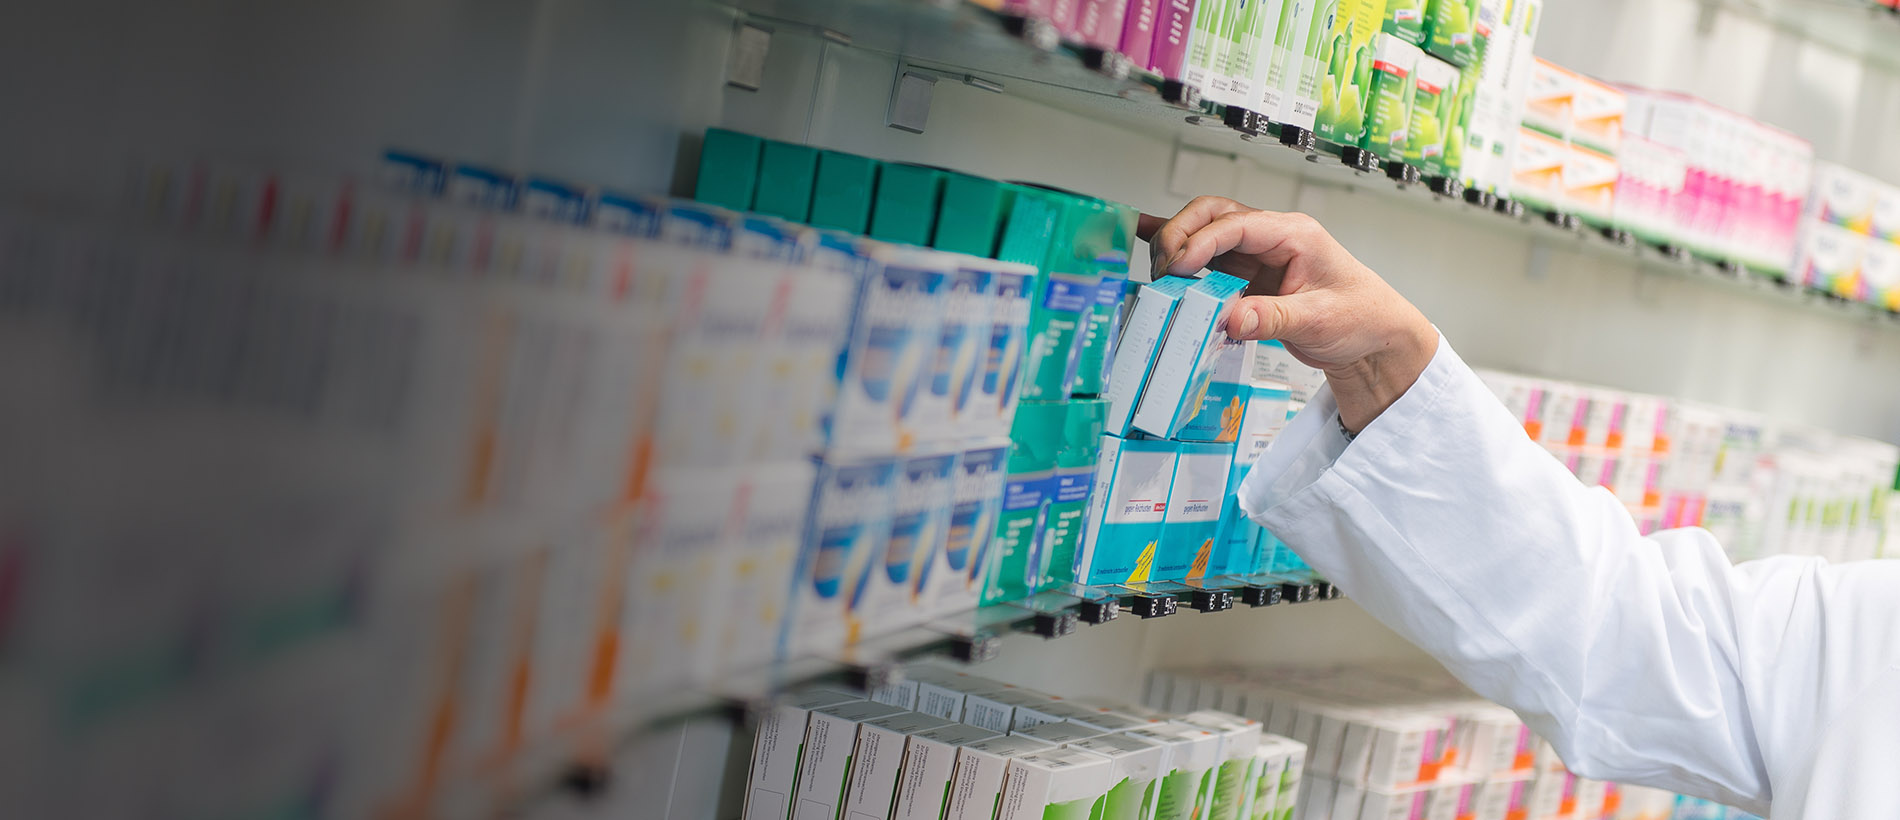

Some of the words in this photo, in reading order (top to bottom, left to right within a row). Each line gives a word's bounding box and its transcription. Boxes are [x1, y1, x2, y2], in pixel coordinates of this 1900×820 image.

[816, 728, 824, 750] Anwendung
[866, 740, 875, 762] Anwendung
[914, 752, 923, 775] Anwendung
[965, 764, 974, 786] Anwendung
